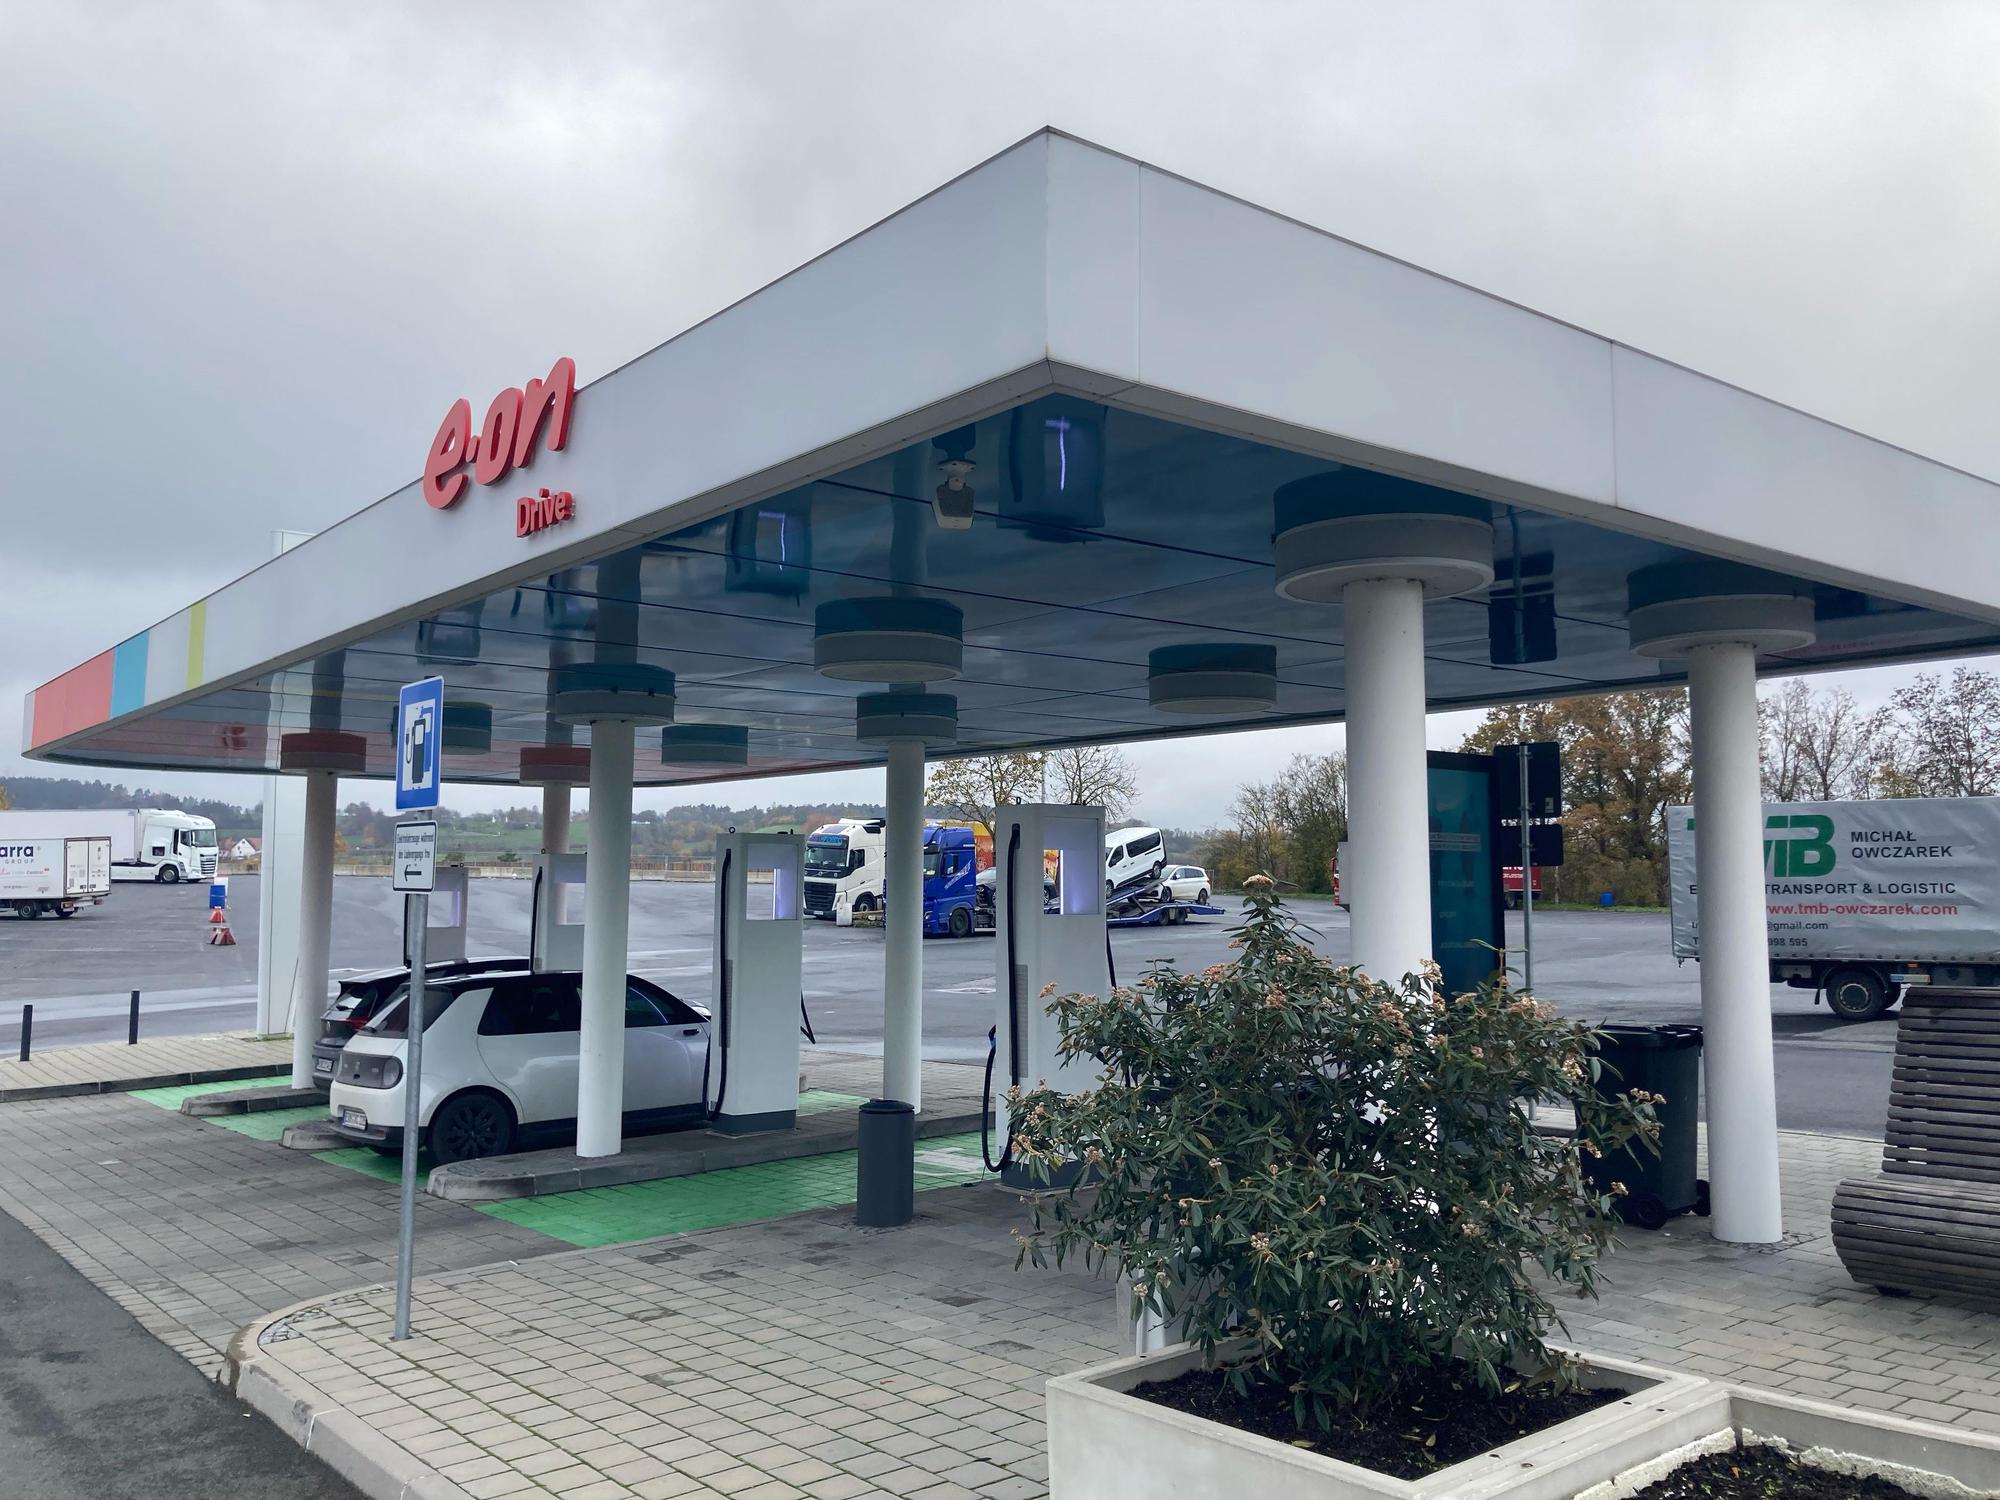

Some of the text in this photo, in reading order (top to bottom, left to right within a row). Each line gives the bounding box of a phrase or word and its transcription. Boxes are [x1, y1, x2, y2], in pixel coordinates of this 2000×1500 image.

[516, 488, 574, 538] Drive
[1850, 831, 1917, 842] MICHAŁ
[1851, 846, 1953, 858] OWCZAREK
[1765, 883, 1956, 895] TRANSPORT & LOGISTIC
[1766, 902, 1958, 915] ww.tmb-owczarek.com
